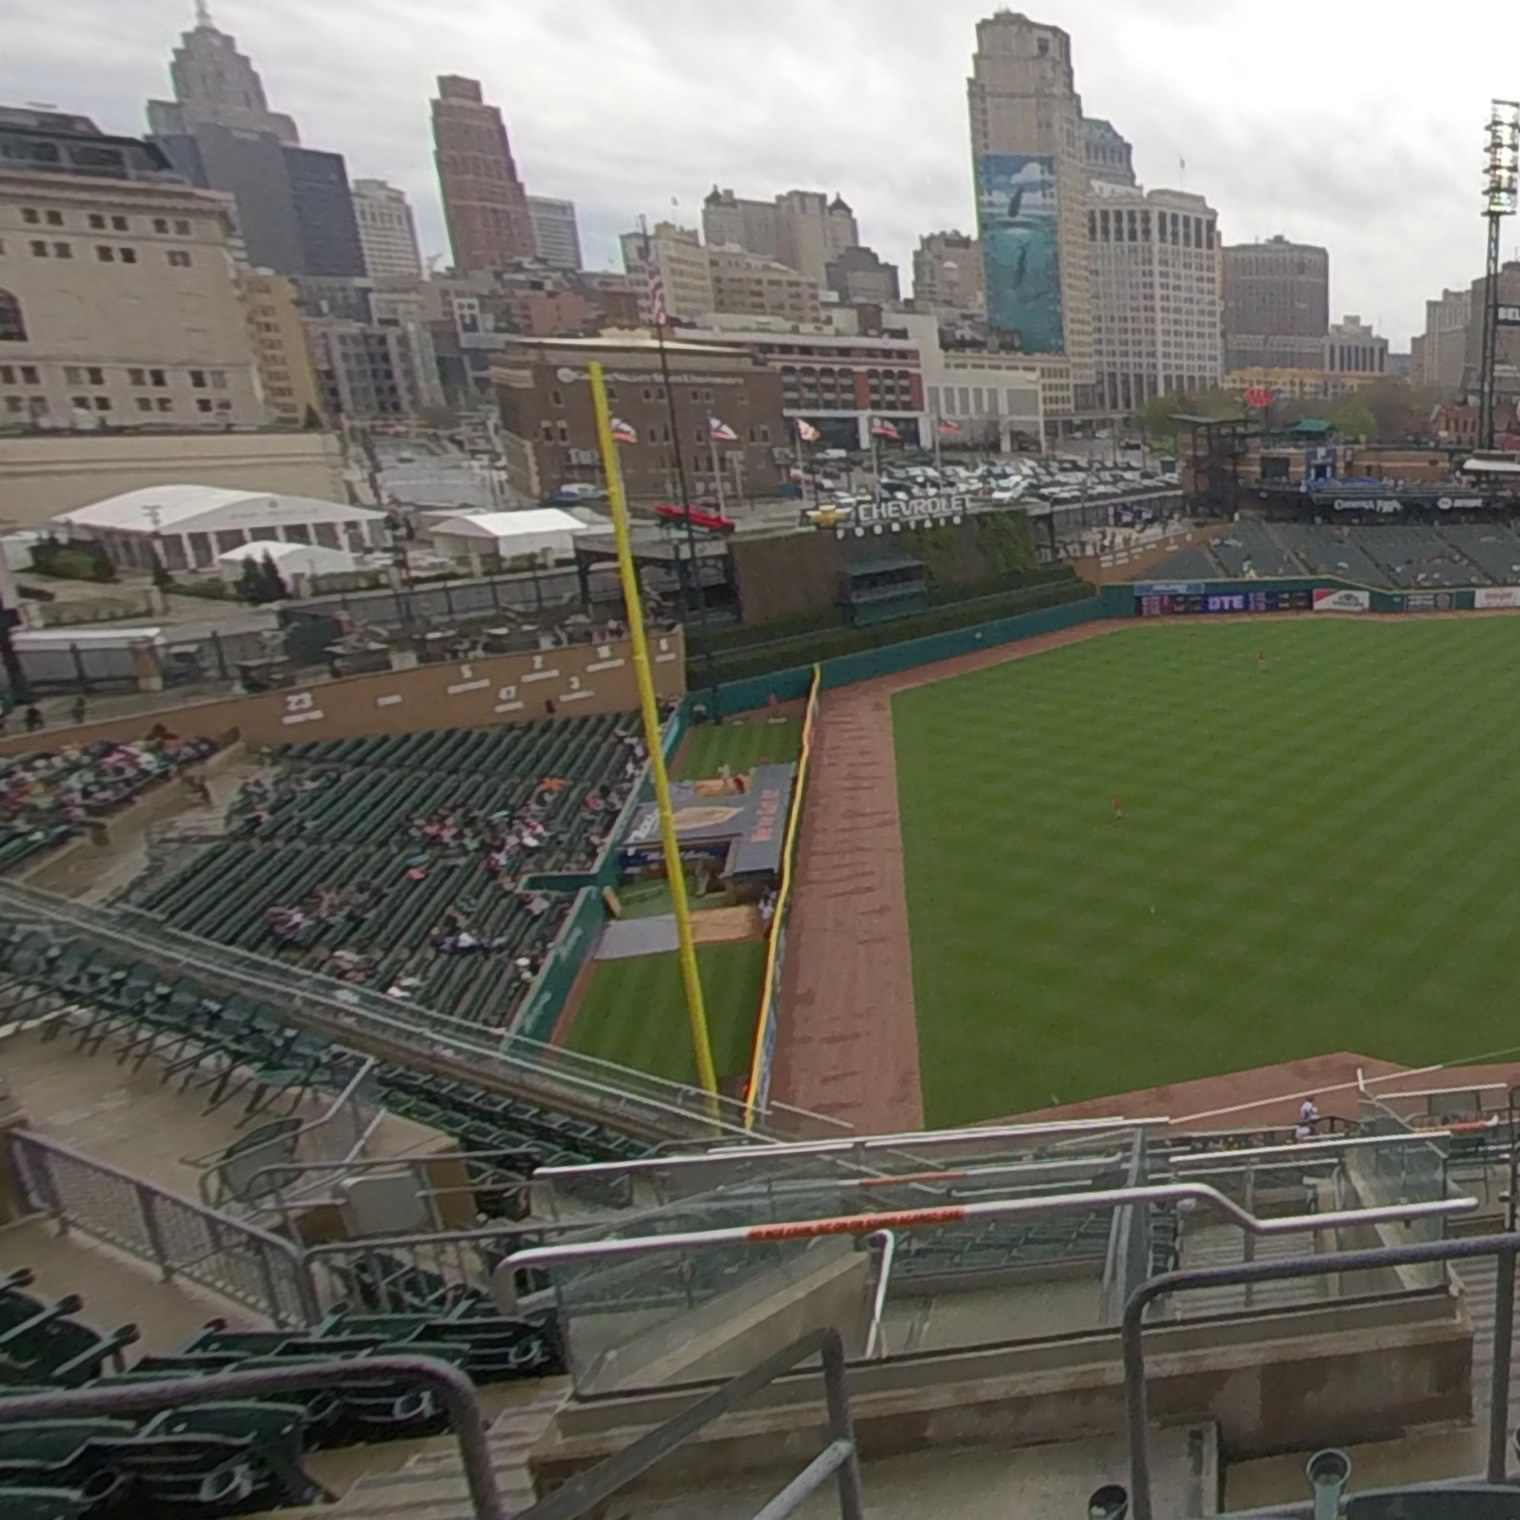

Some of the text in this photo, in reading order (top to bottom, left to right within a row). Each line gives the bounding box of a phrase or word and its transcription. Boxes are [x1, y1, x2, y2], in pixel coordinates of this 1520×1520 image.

[858, 494, 973, 521] CHEVROLET
[1207, 595, 1244, 610] DTE
[533, 655, 543, 669] 2
[568, 676, 580, 690] 3
[286, 692, 313, 711] 23
